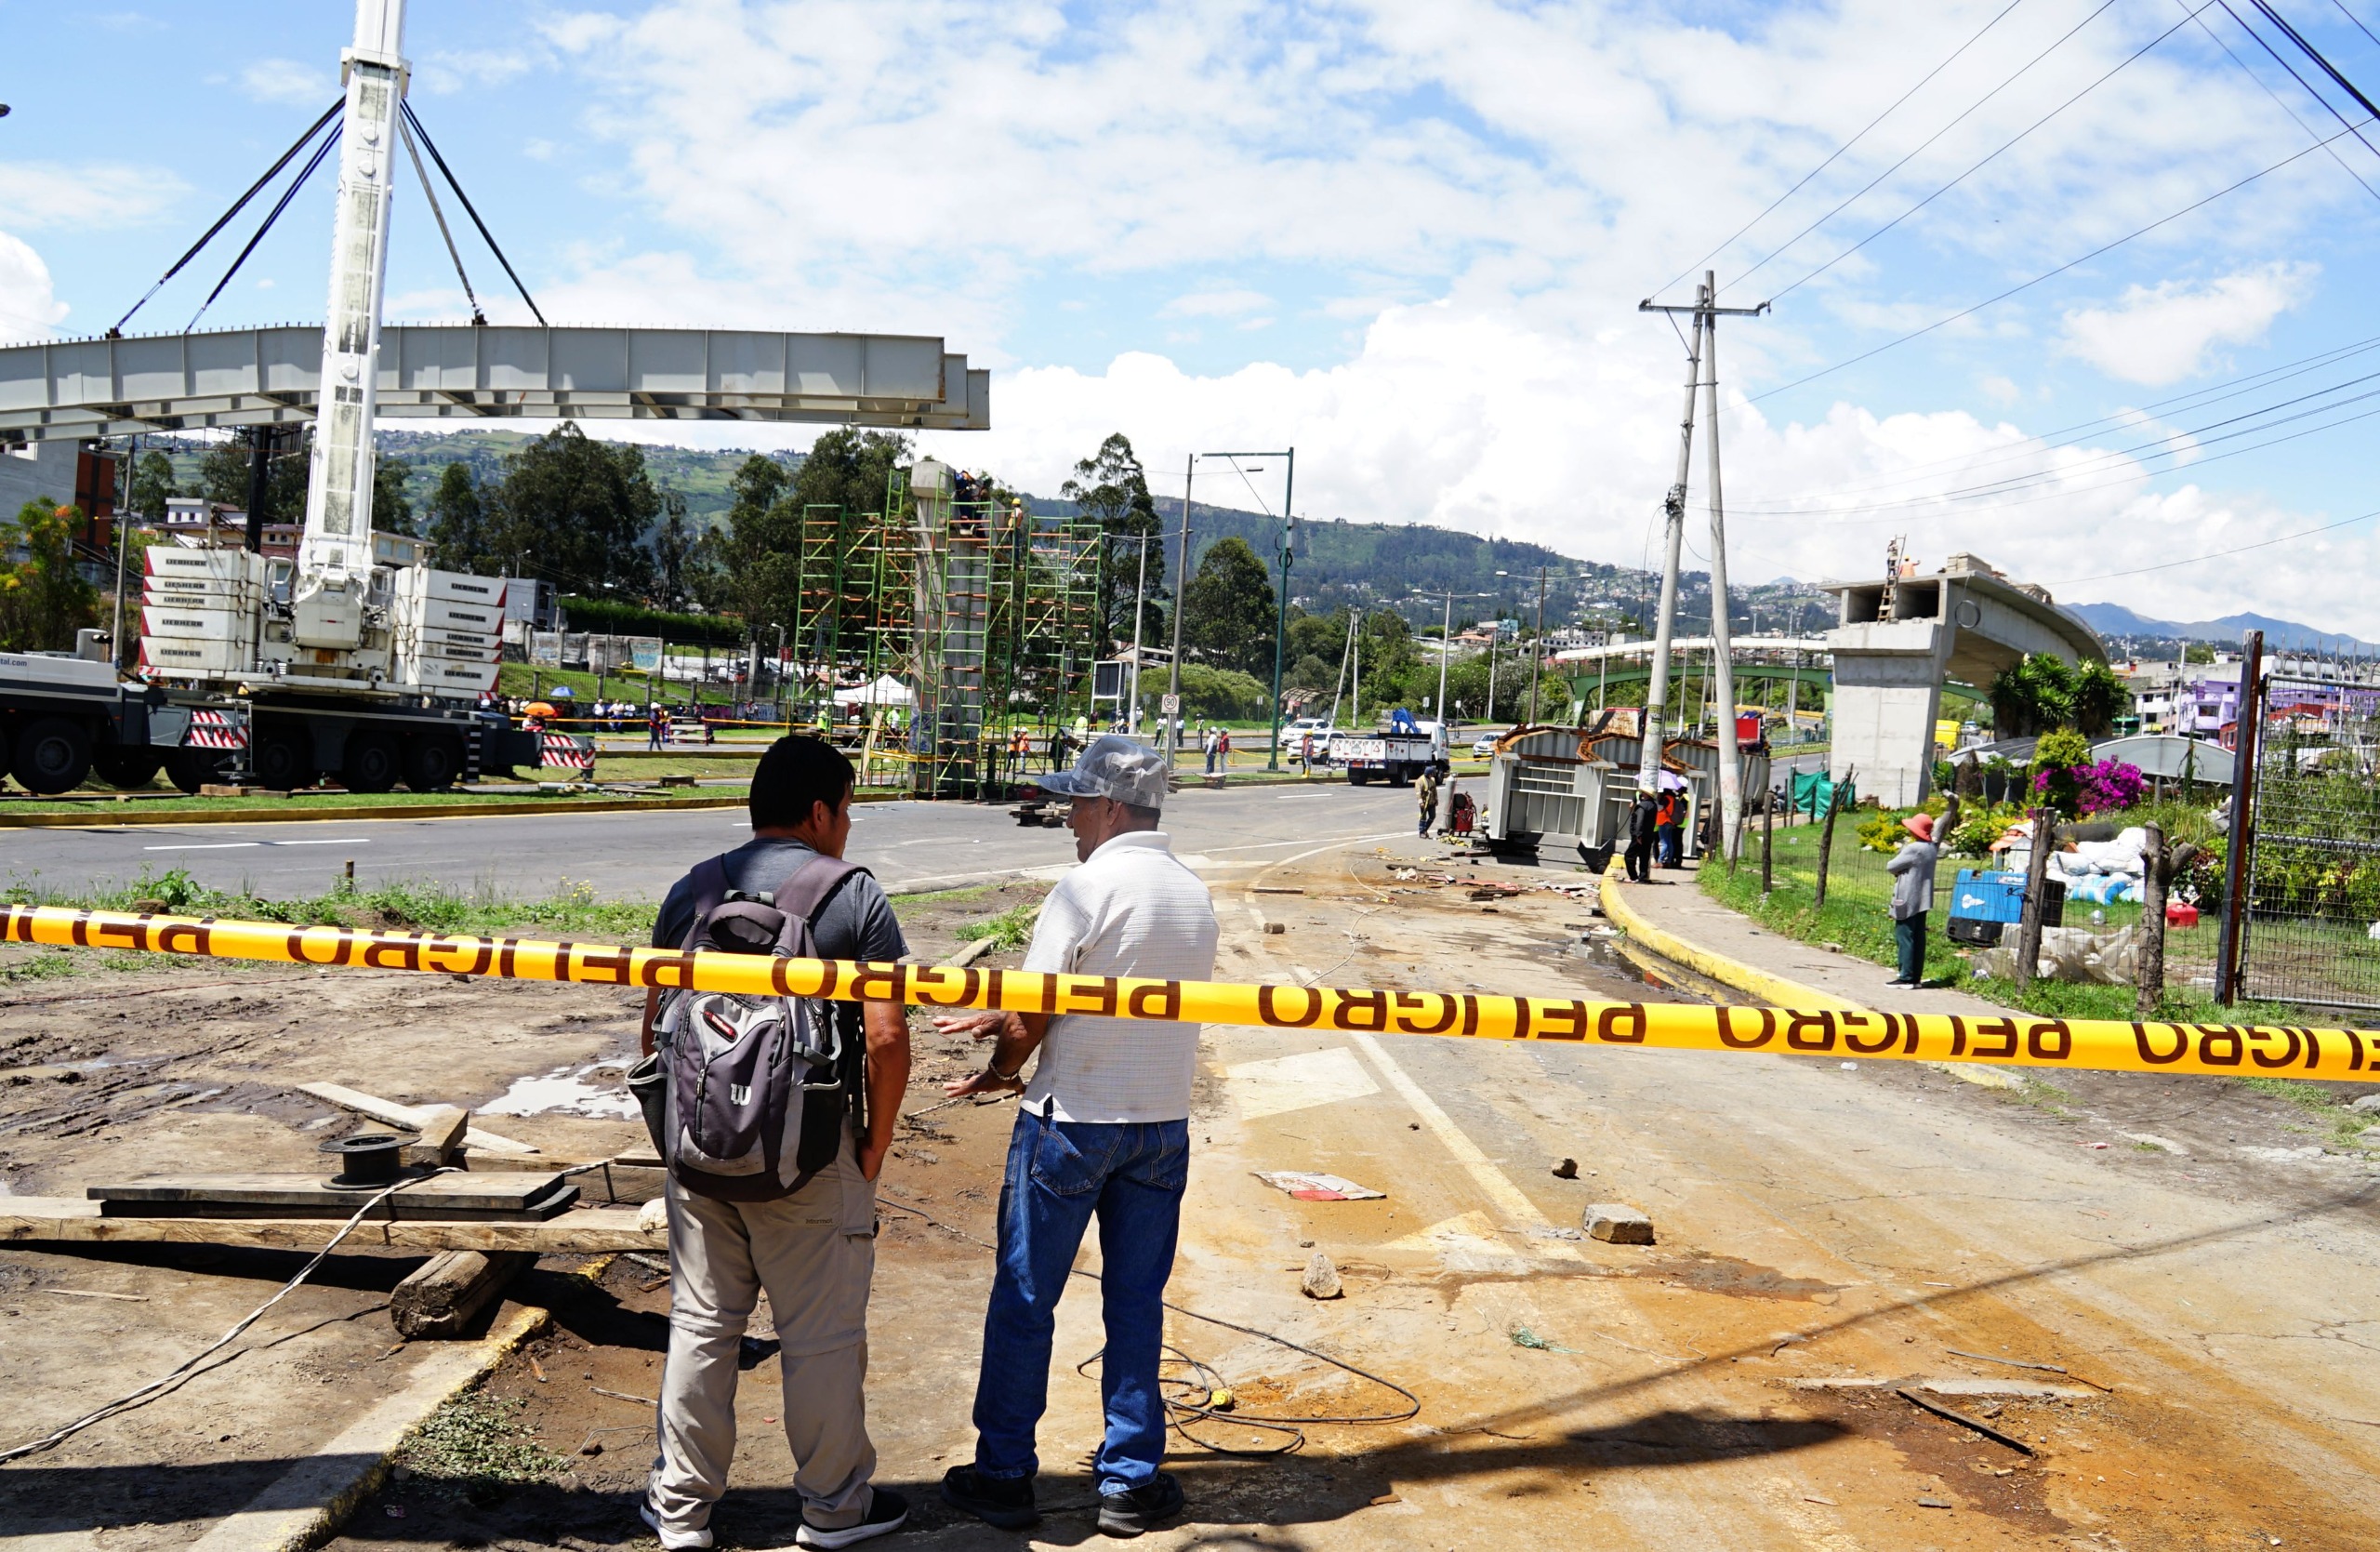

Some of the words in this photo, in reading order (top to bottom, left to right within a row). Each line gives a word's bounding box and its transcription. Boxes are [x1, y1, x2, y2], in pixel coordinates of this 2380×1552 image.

[165, 558, 207, 566] LIEBHERR
[162, 618, 204, 627] LIEBHERR
[160, 648, 202, 657] LIEBHERR
